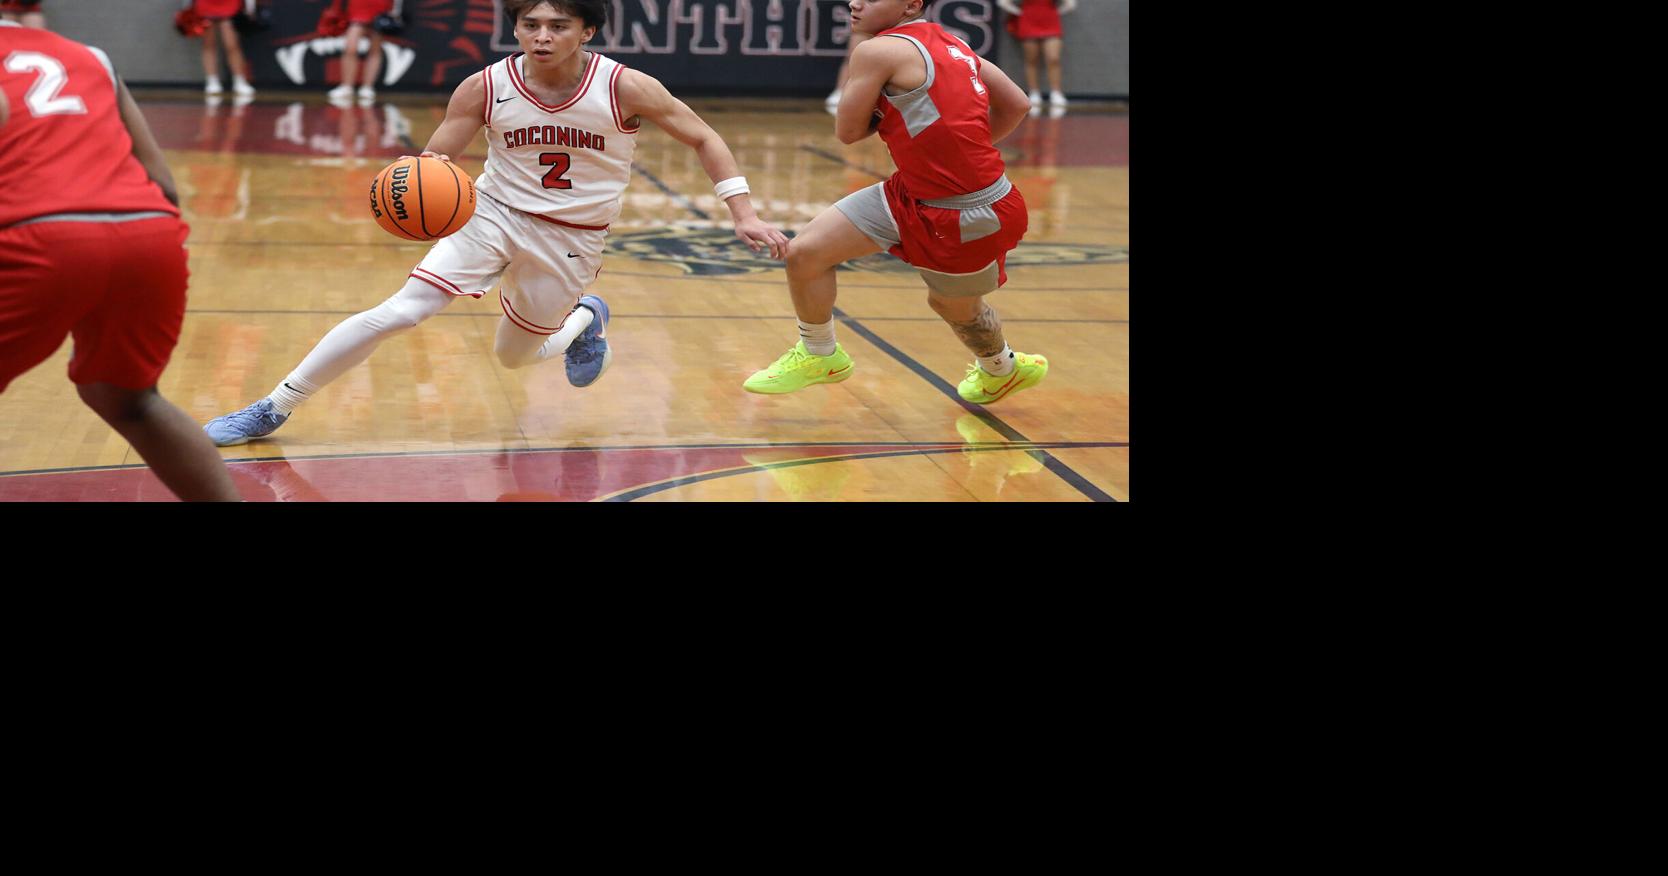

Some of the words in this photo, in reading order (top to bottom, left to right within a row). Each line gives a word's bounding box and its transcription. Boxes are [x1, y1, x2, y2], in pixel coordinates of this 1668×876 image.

[490, 0, 993, 54] NTHES
[3, 50, 89, 118] 2
[503, 125, 606, 151] COCONINO
[391, 164, 411, 221] Wilson
[538, 152, 572, 190] 2
